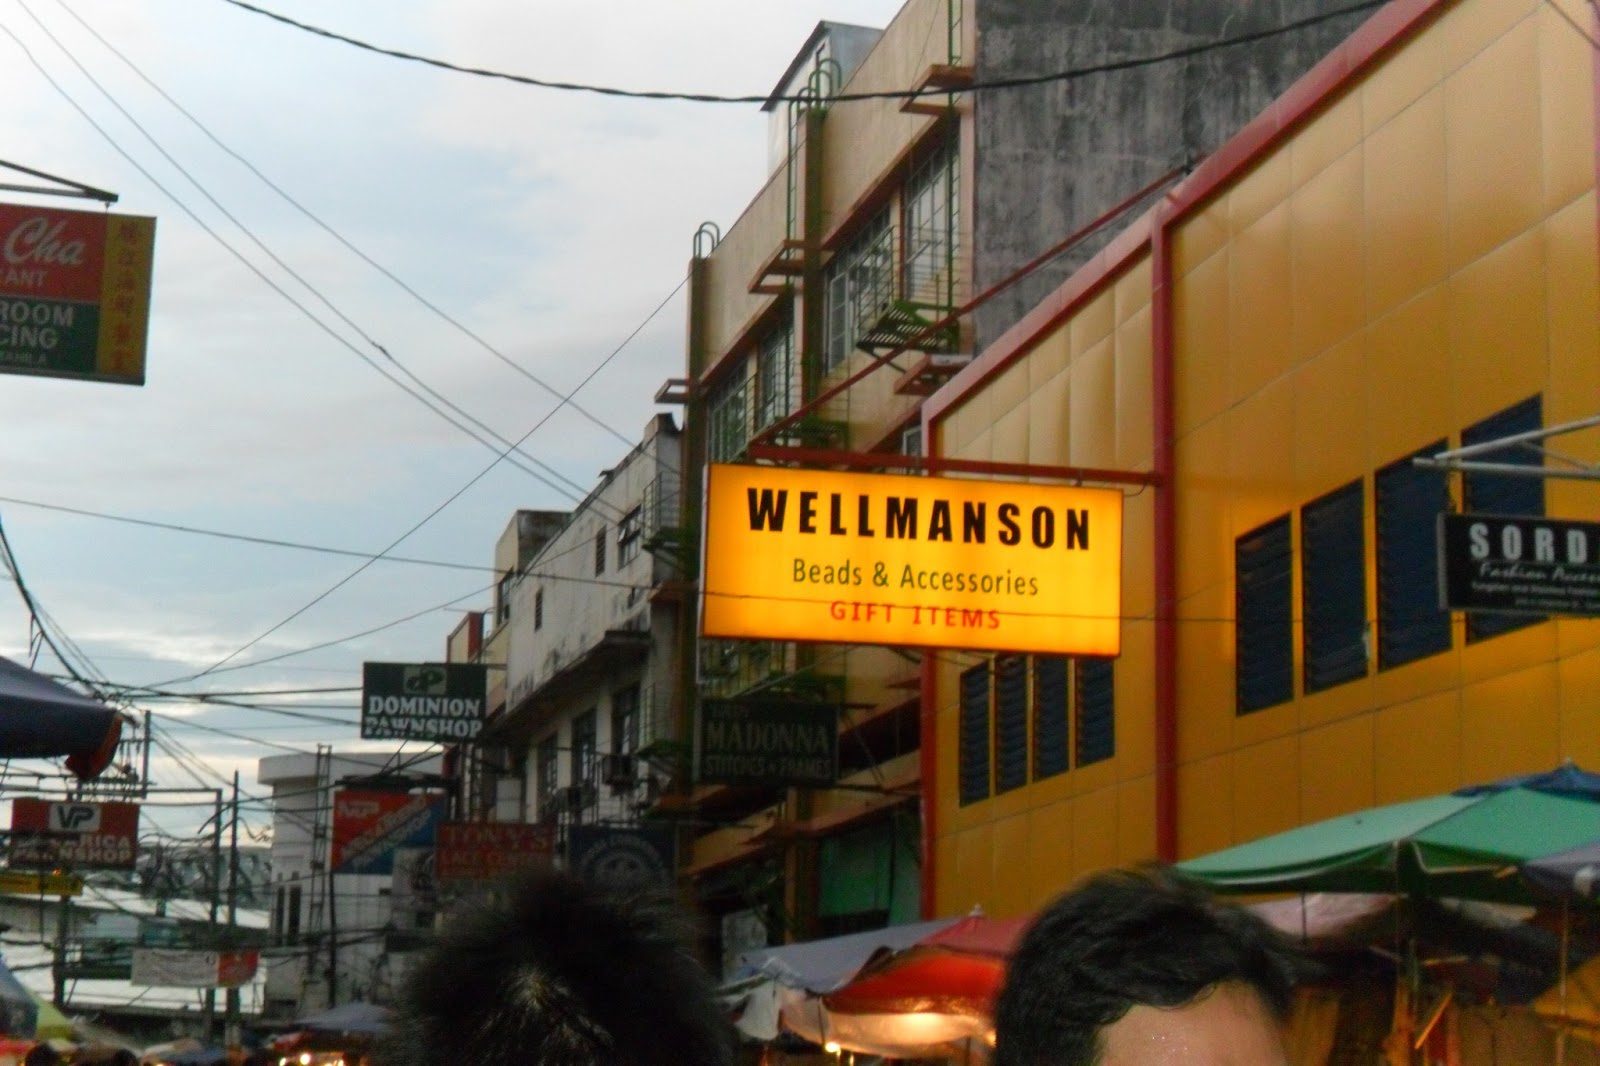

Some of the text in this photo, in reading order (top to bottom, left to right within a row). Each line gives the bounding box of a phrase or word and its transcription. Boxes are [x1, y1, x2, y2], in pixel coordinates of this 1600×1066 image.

[4, 216, 85, 265] Cha
[0, 267, 48, 288] ANT
[747, 487, 1089, 550] WELLMANSON
[792, 557, 1039, 596] Beads & Accessories
[830, 600, 1001, 630] GIFT ITEMS
[368, 695, 480, 717] DOMINION
[364, 716, 483, 738] PAWNSHOP
[706, 720, 830, 754] MADONNA
[57, 805, 95, 829] VP
[12, 847, 132, 863] PANSHOP
